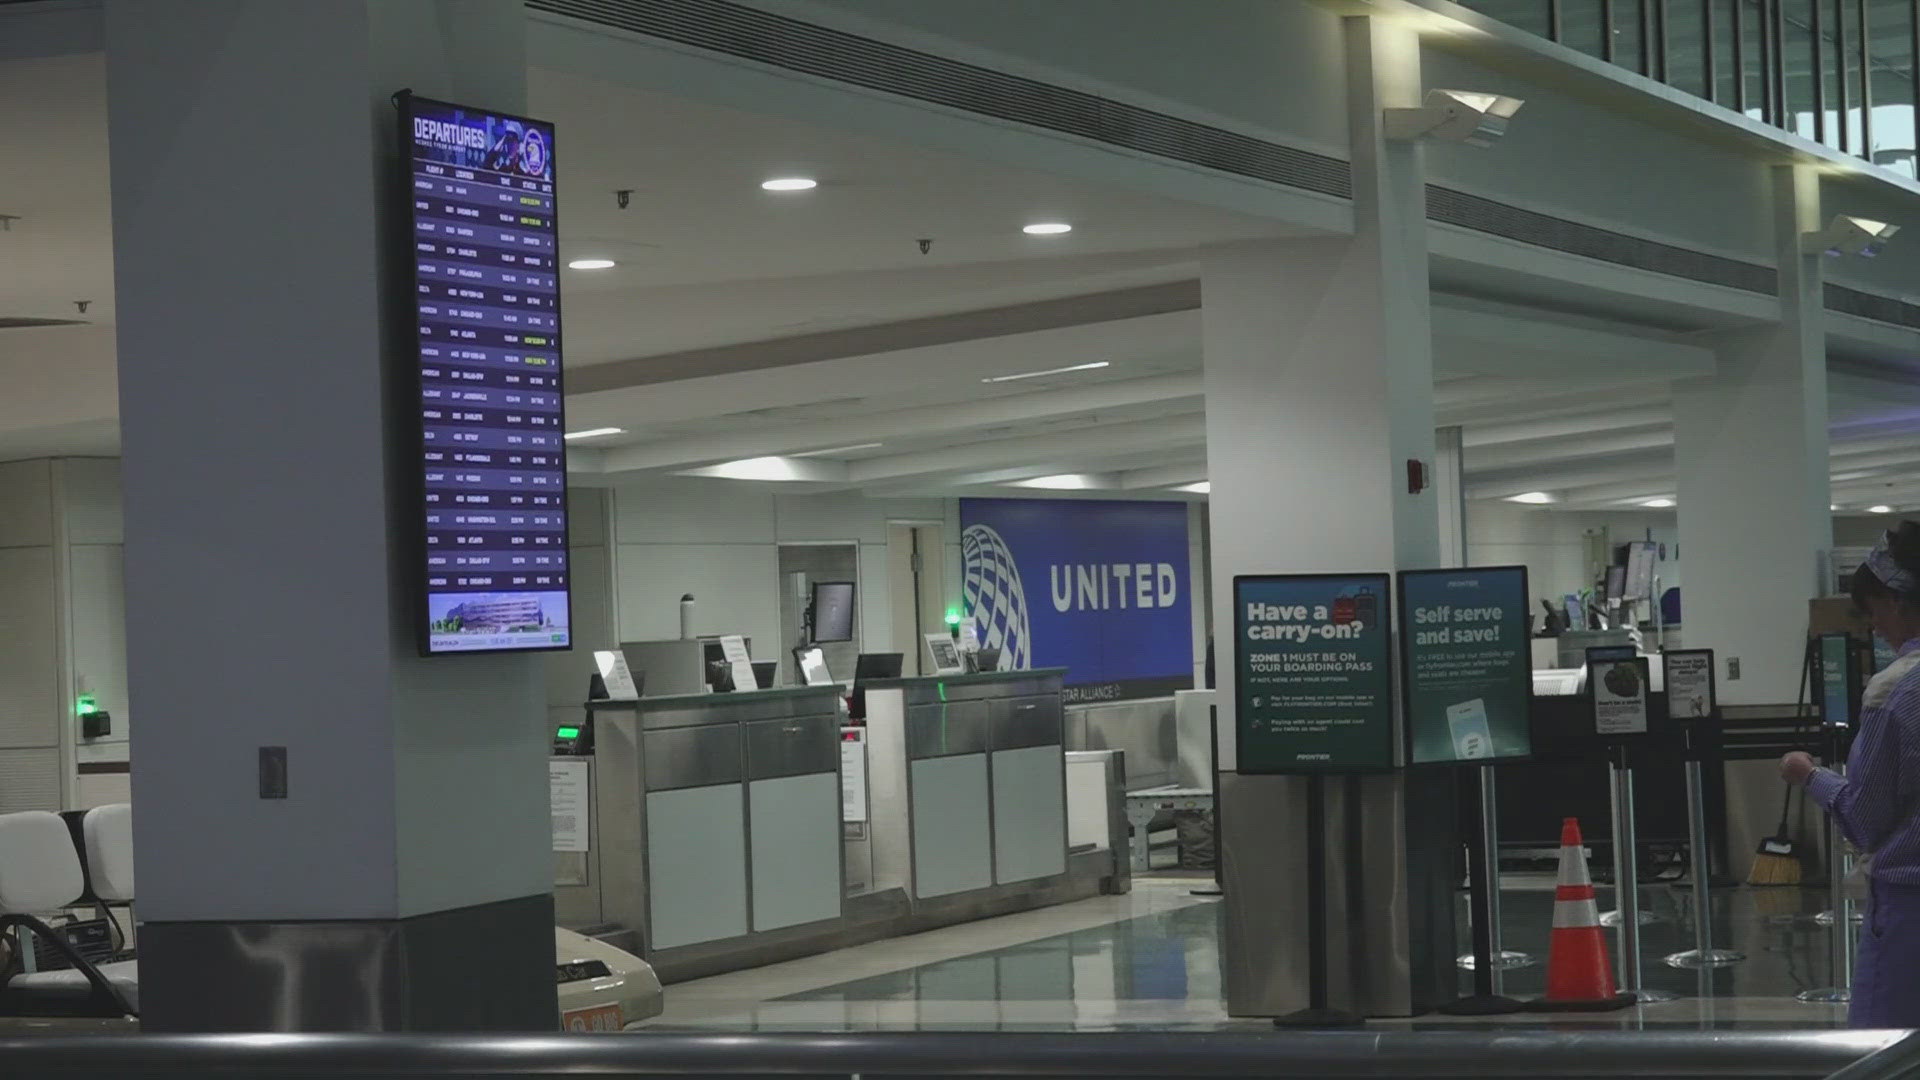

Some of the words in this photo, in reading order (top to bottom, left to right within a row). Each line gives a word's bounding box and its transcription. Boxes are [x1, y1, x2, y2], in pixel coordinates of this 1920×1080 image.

[414, 117, 485, 149] DEPARTURES
[1051, 563, 1177, 612] UNITED
[1247, 602, 1308, 621] Have
[1313, 605, 1328, 620] a
[1415, 606, 1450, 624] Self
[1453, 607, 1503, 622] serve
[1247, 620, 1364, 643] carry-on?
[1416, 627, 1450, 645] and
[1454, 625, 1500, 643] save!
[1250, 653, 1280, 663] ZONE
[1282, 653, 1288, 662] 1
[1290, 653, 1320, 662] MUST
[1322, 653, 1337, 662] BE
[1339, 652, 1357, 661] ON
[1250, 663, 1281, 672] YOUR
[1284, 662, 1343, 672] BOARDING
[1345, 662, 1373, 671] PASS
[1062, 687, 1079, 702] STAR
[1080, 685, 1114, 700] ALLIANCE
[1296, 753, 1330, 761] FRONTIER
